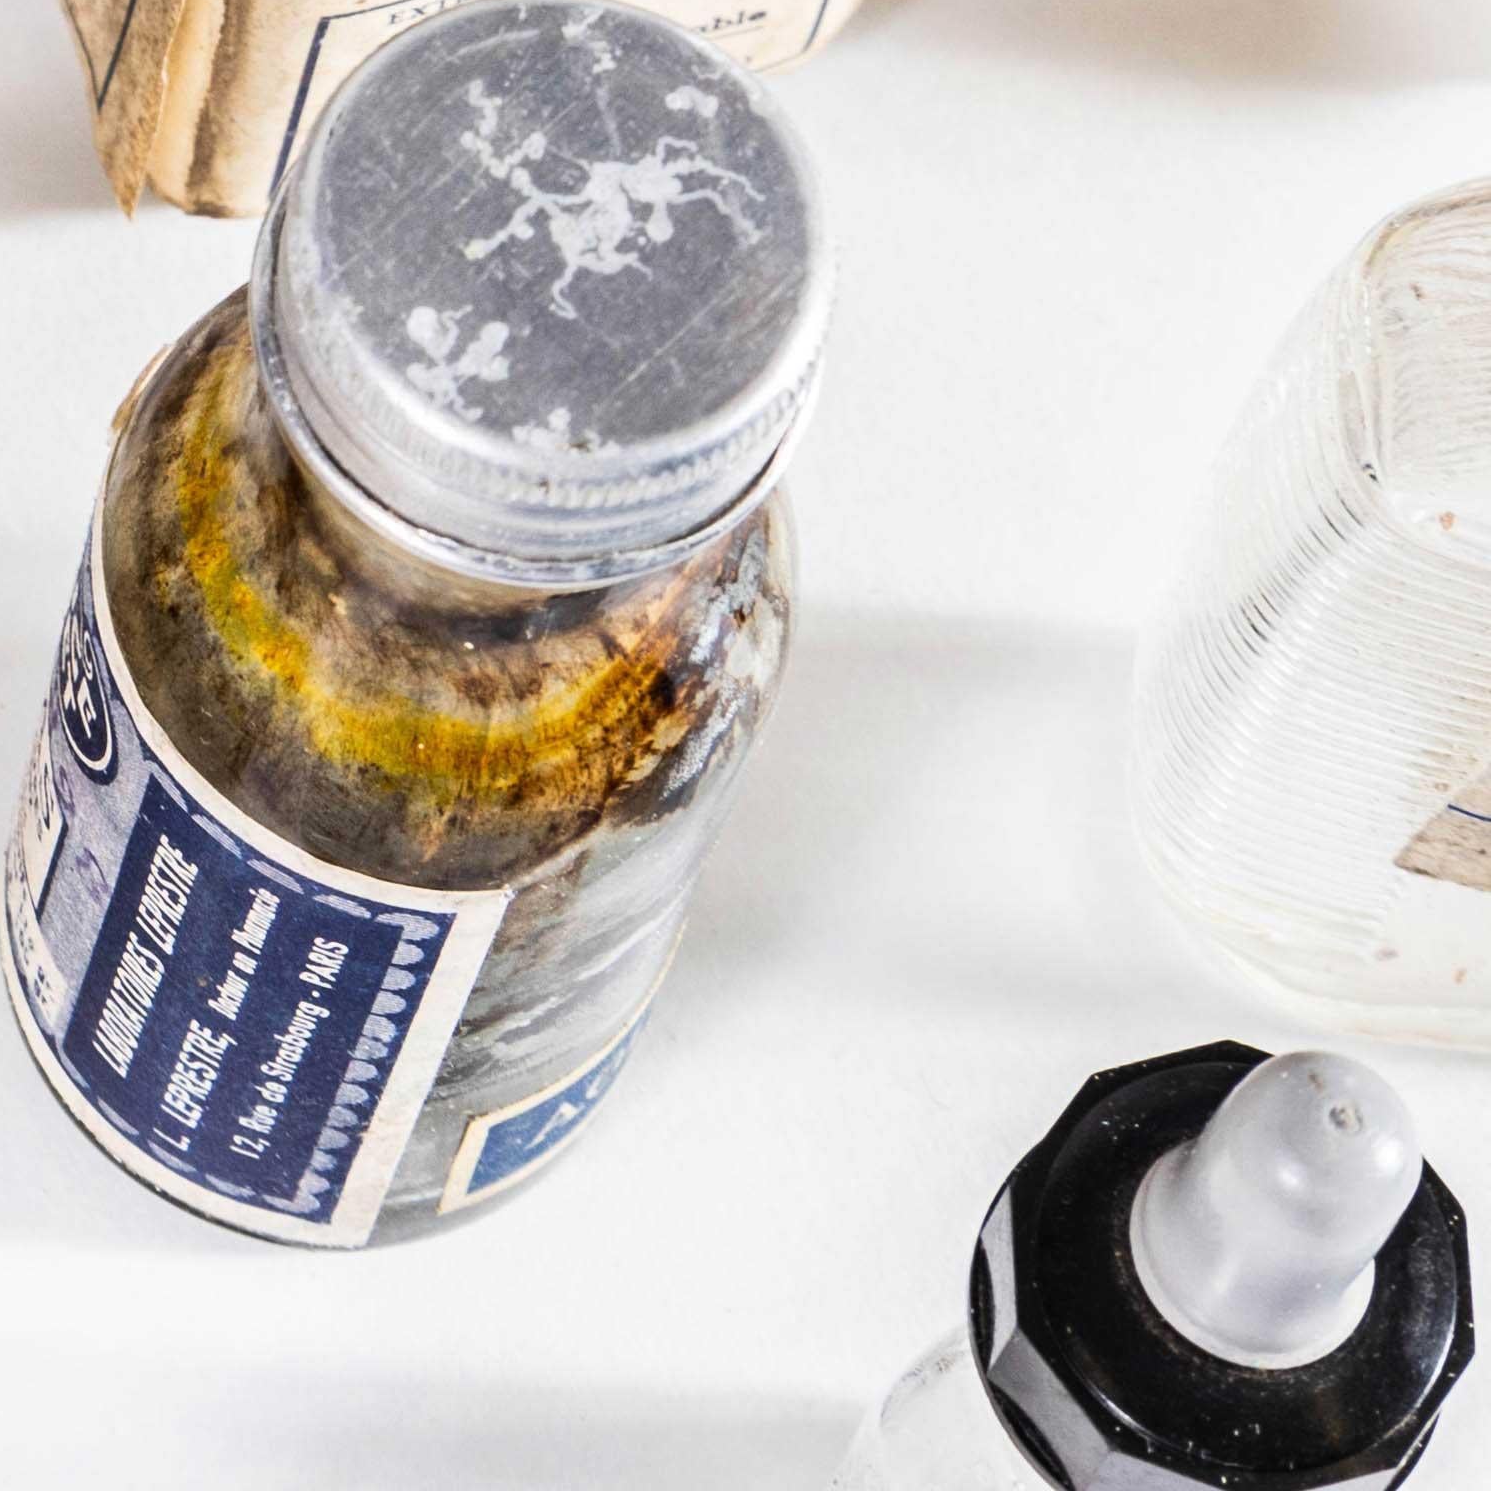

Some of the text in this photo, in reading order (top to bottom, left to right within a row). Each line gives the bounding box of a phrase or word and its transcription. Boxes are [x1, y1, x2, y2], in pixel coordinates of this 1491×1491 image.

[230, 887, 281, 955] Pharmacie
[91, 833, 200, 1079] LABORATOIRES LEPRESTRE
[232, 951, 259, 976] en
[299, 936, 350, 990] PARIS
[259, 1000, 331, 1082] Strasbourg
[160, 1018, 239, 1131] LEPRESTRE,
[254, 1081, 289, 1104] de
[237, 1103, 278, 1136] Rue
